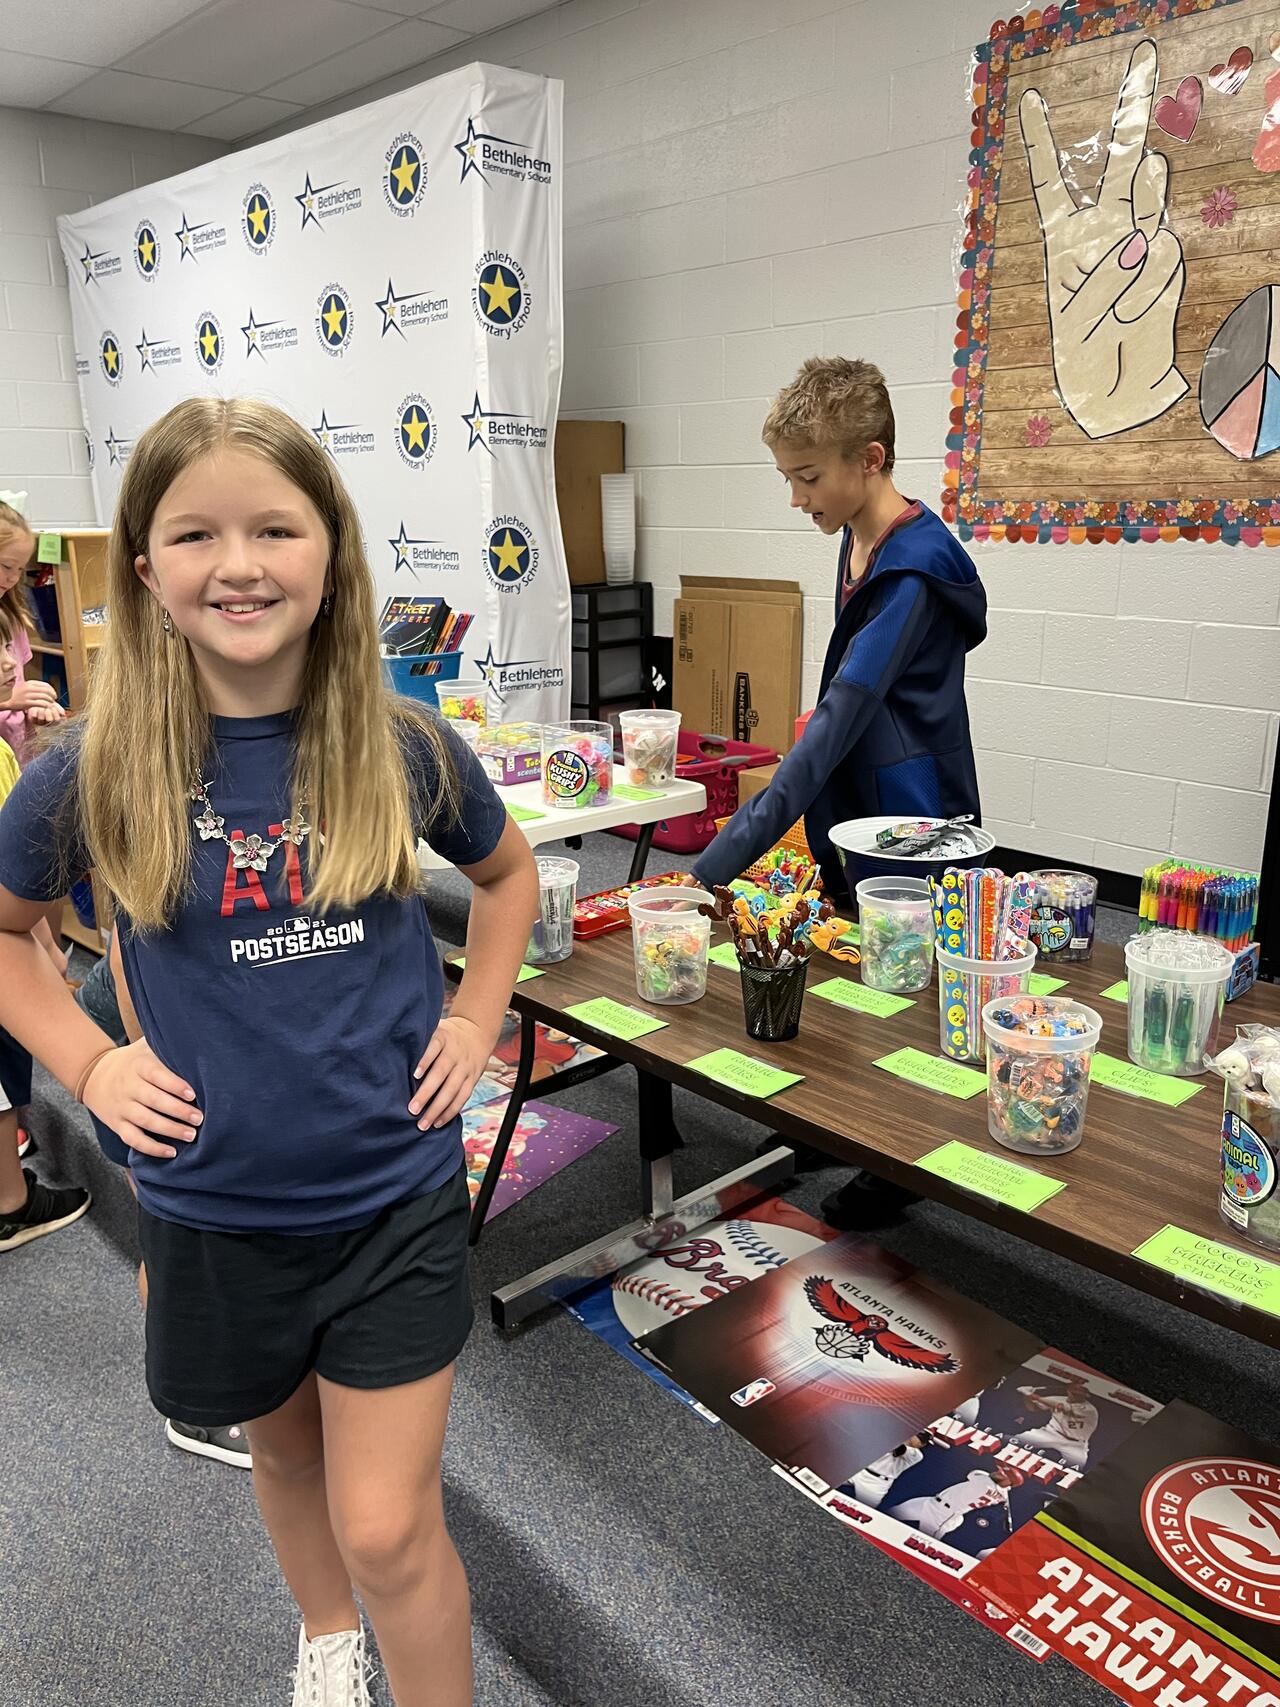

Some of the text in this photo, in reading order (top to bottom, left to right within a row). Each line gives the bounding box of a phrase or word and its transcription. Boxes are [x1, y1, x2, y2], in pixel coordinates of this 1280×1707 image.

[385, 131, 423, 162] Bethlehem
[482, 143, 551, 173] Bethlehem
[482, 161, 551, 184] Elementary School
[318, 187, 361, 209] Bethlehem
[382, 162, 428, 218] Elementary School
[318, 200, 362, 219] Elementary School
[192, 228, 226, 245] Bethlehem
[94, 256, 121, 271] Bethlehem
[475, 250, 525, 281] Bethlehem
[400, 298, 448, 318] Bethlehem
[400, 311, 448, 328] Elementary School
[471, 288, 532, 340] Elementary School
[260, 327, 297, 342] Bethlehem
[151, 346, 181, 359] Bethlehem
[397, 392, 432, 416] Bethlehem
[333, 432, 374, 445] Bethlehem
[488, 421, 547, 438] Bethlehem
[394, 424, 438, 471] Elementary School
[488, 436, 547, 448] Elementary School
[485, 515, 532, 539] Bethlehem
[412, 547, 459, 561] Bethlehem
[413, 561, 459, 572] Elementary School
[482, 548, 540, 595] Elementary School
[385, 615, 431, 624] RACERS
[388, 603, 436, 615] STREET
[499, 679, 564, 692] Elementary School
[500, 667, 564, 683] Bethlehem
[550, 763, 583, 782] KUSHY
[550, 773, 577, 789] GRIPS
[220, 823, 305, 917] AT
[266, 919, 327, 936] 20 21
[230, 918, 365, 963] POSTSEASON
[952, 1172, 979, 1185] STAR
[980, 1183, 1015, 1199] POINTS
[647, 1238, 750, 1291] Bra
[1194, 1240, 1272, 1274] DOGGY
[1182, 1264, 1216, 1280] STAR
[1218, 1279, 1264, 1299] POINTS
[839, 1280, 947, 1350] ATLANTA HAWKS
[1067, 1420, 1085, 1430] 27
[973, 1421, 1047, 1456] LEAGUE
[927, 1415, 1085, 1491] AVY HITT
[1191, 1468, 1280, 1491] ATLAN
[1159, 1490, 1266, 1608] BASKETBALL
[1027, 1592, 1210, 1707] HAWK
